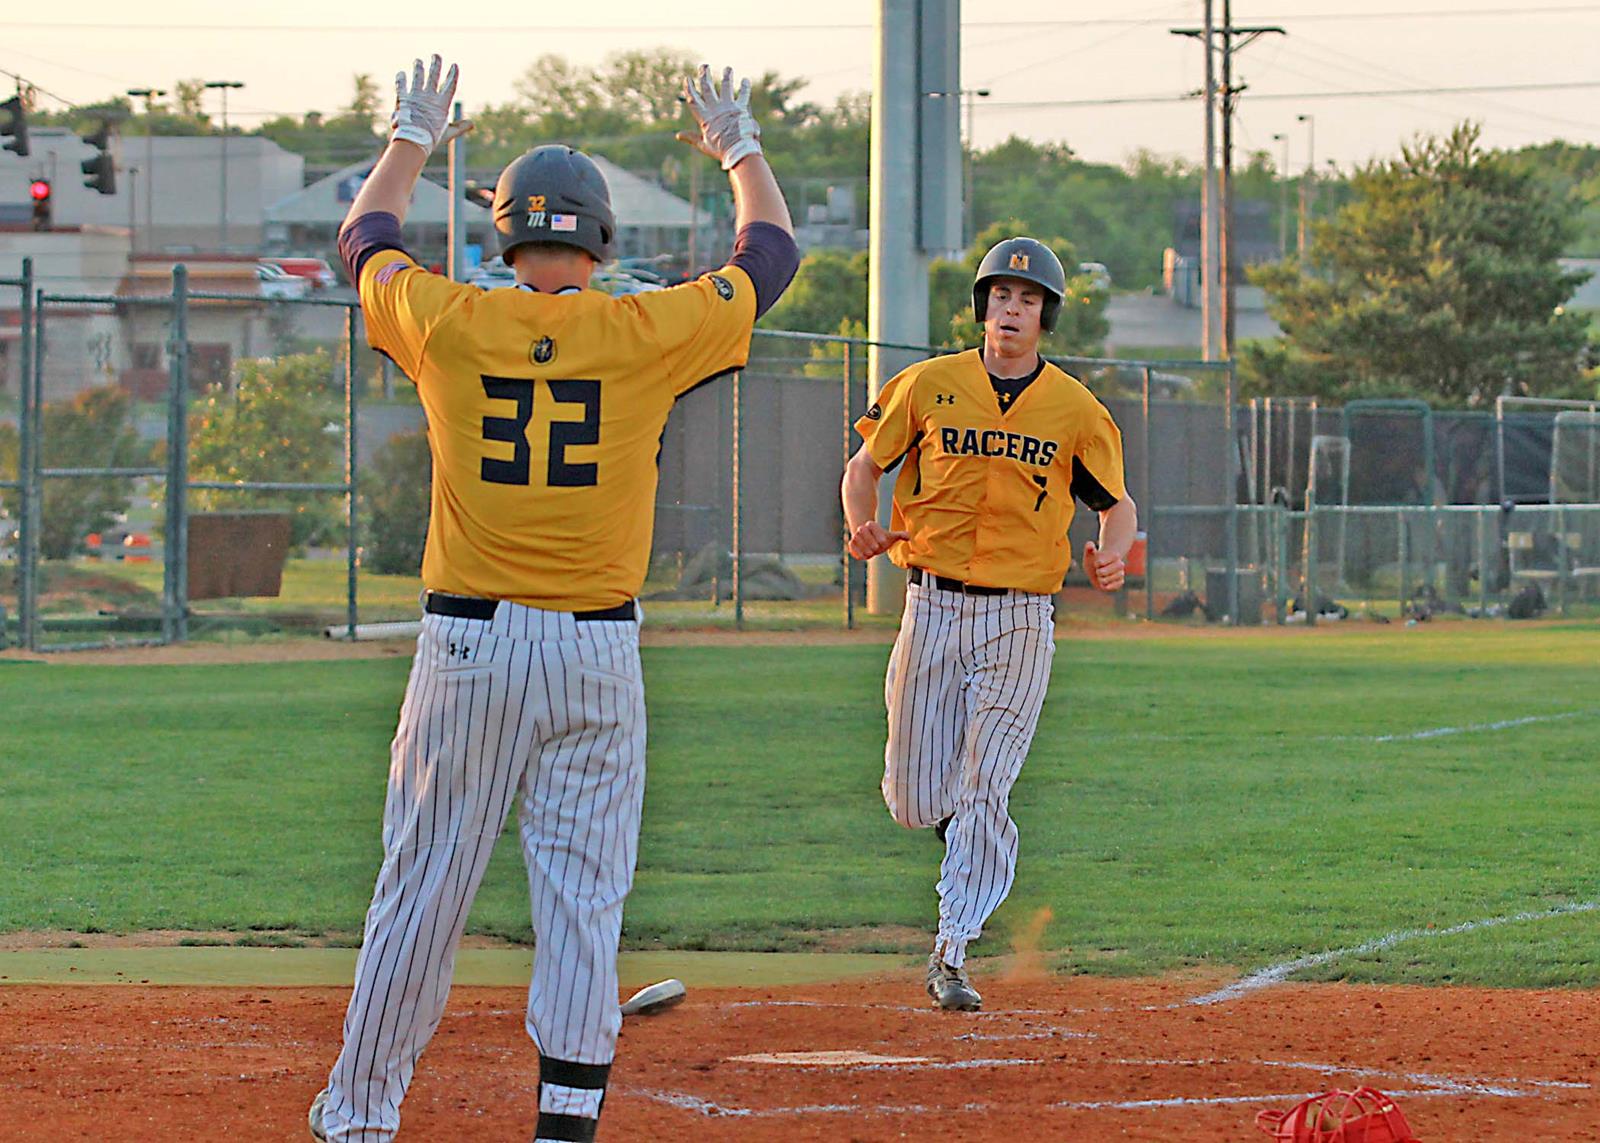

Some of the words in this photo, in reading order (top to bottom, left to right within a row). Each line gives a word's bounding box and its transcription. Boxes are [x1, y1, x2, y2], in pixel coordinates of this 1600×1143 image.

[527, 195, 547, 212] 32
[480, 374, 601, 487] 32
[941, 427, 1058, 467] RACERS
[1032, 474, 1048, 512] 7
